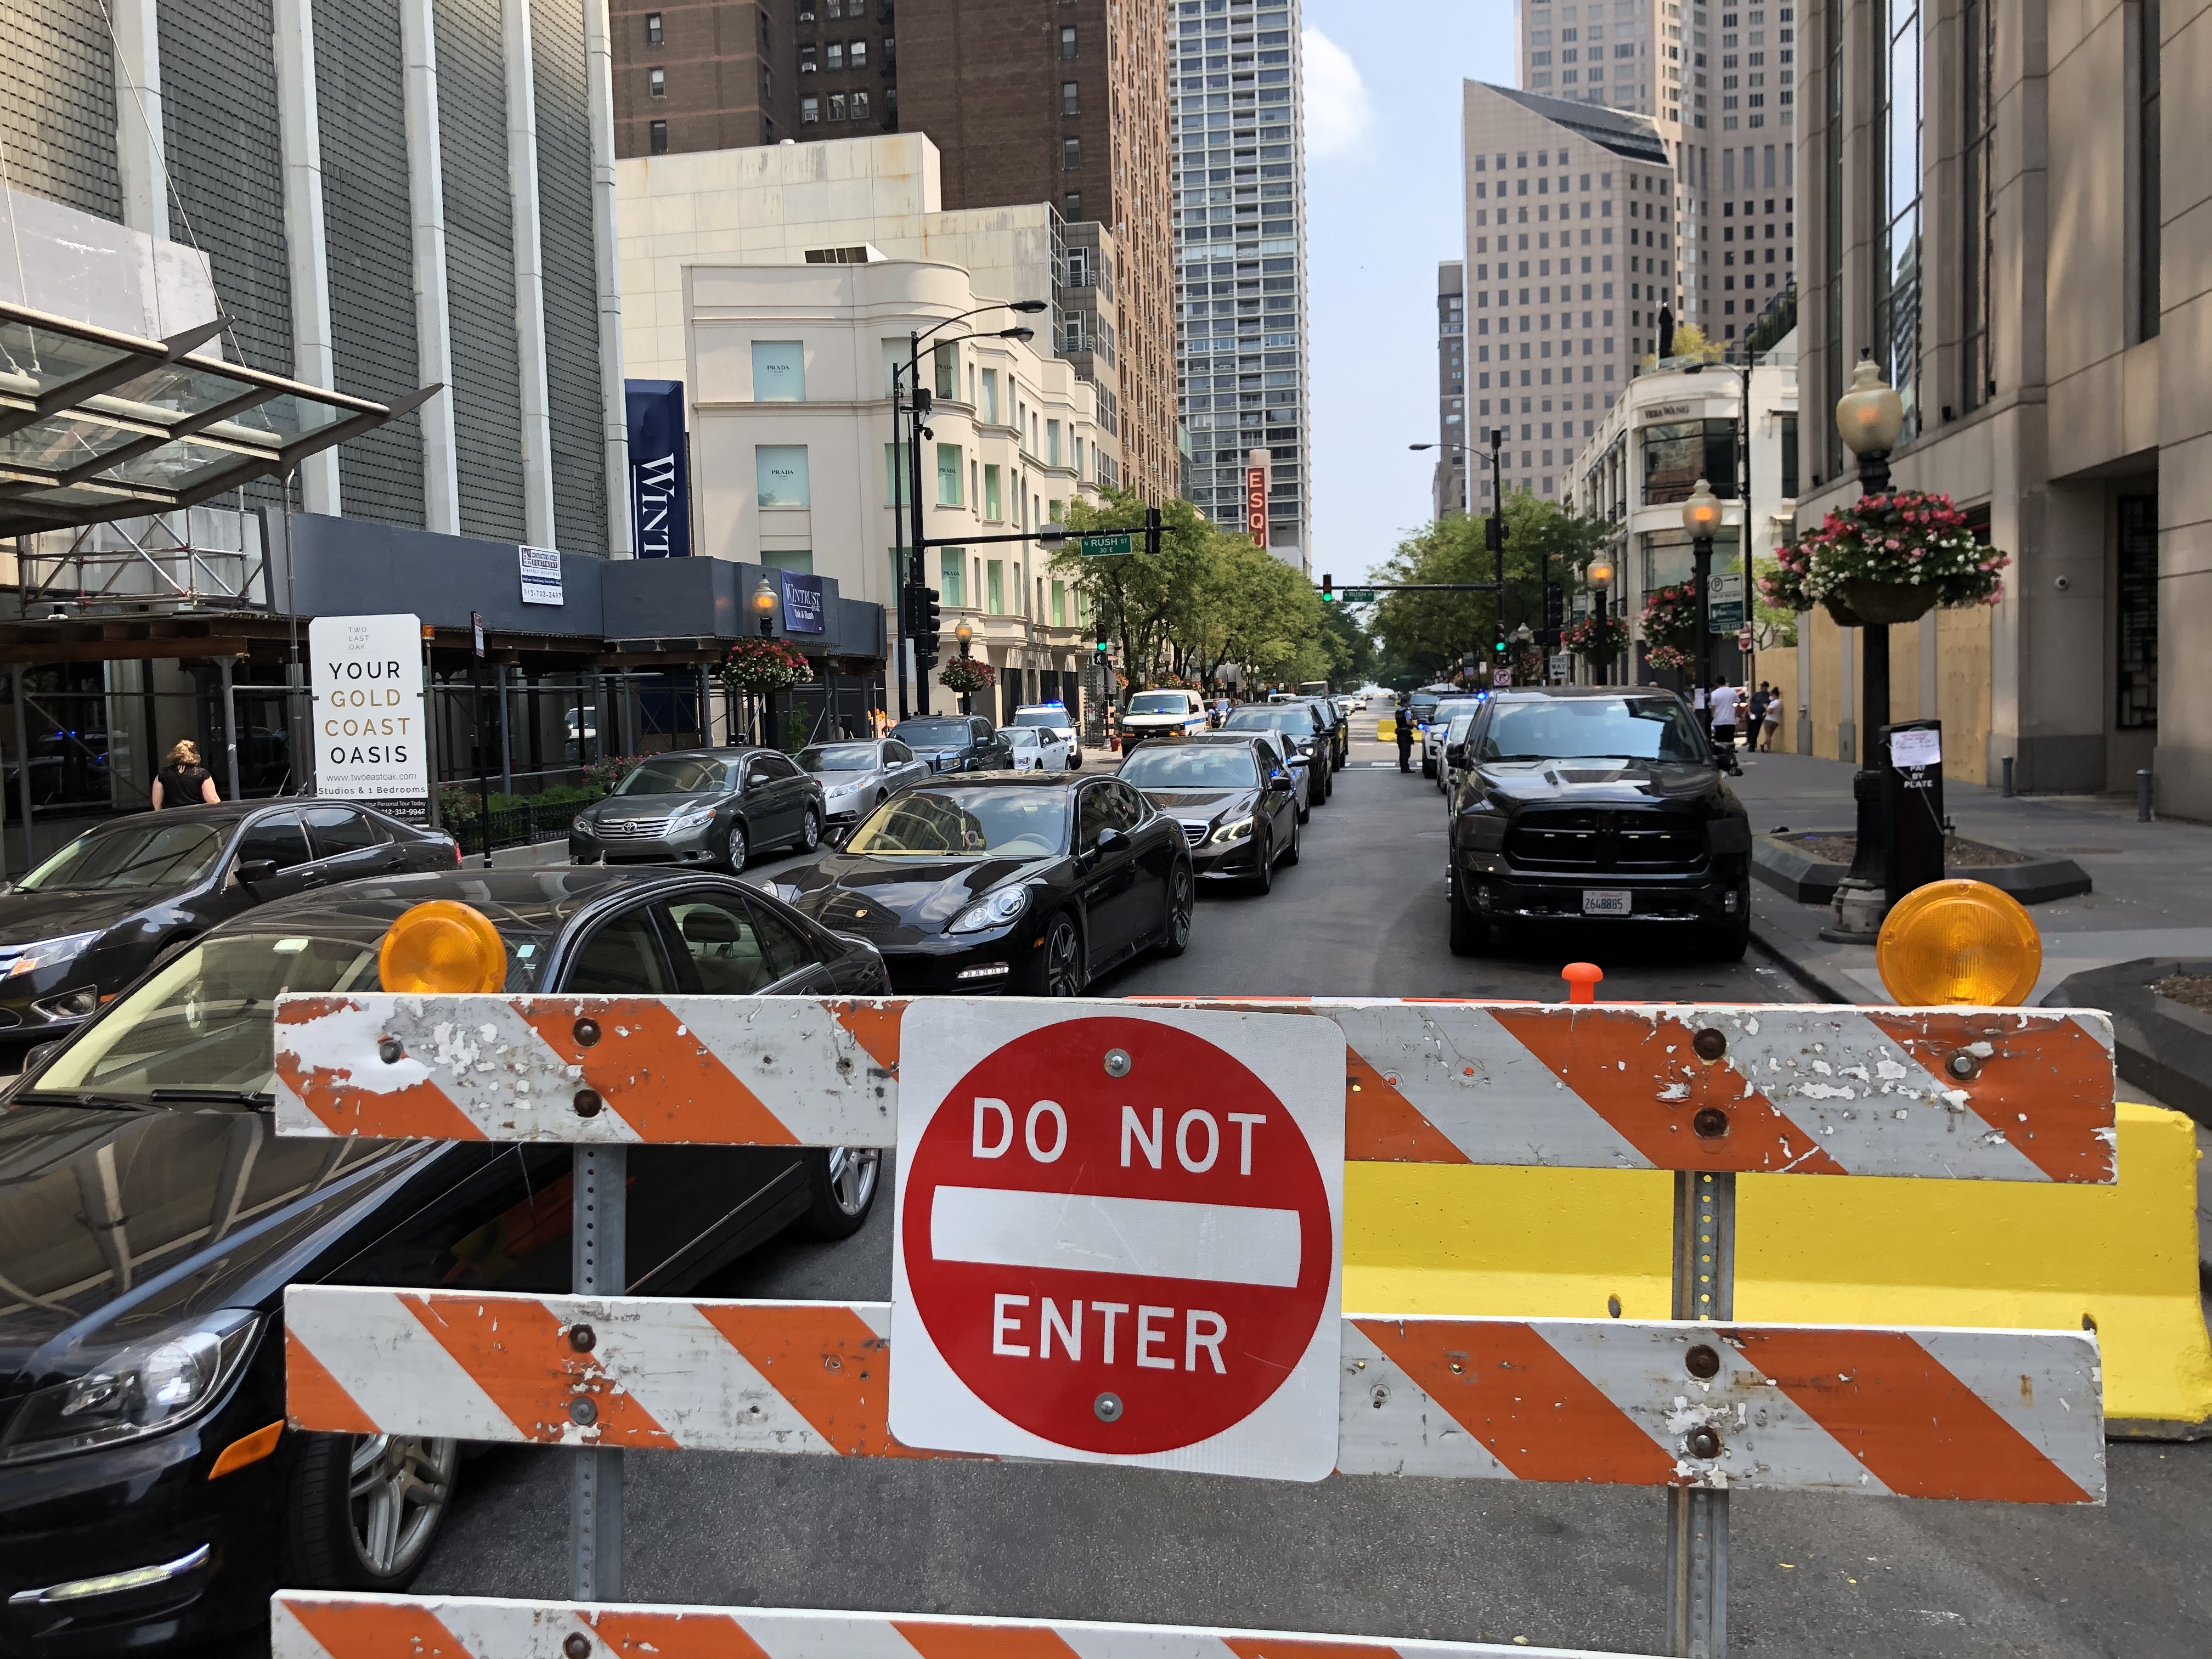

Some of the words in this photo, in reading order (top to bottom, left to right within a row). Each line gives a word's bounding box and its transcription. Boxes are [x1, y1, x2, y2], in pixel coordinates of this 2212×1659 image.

[1091, 538, 1118, 547] RUSH
[785, 583, 821, 605] WINTRUST
[801, 610, 804, 619] &
[804, 610, 814, 619] Rush
[329, 661, 400, 680] YOUR
[331, 689, 400, 707] GOLD
[325, 717, 410, 737] COAST
[330, 746, 407, 764] OASIS
[326, 772, 416, 781] www.twoeastoak.com
[1904, 780, 1933, 788] PLATE
[376, 786, 426, 794] Bedrooms
[972, 1097, 1068, 1164] DO
[1119, 1105, 1267, 1176] NOT
[992, 1293, 1228, 1375] ENTER
